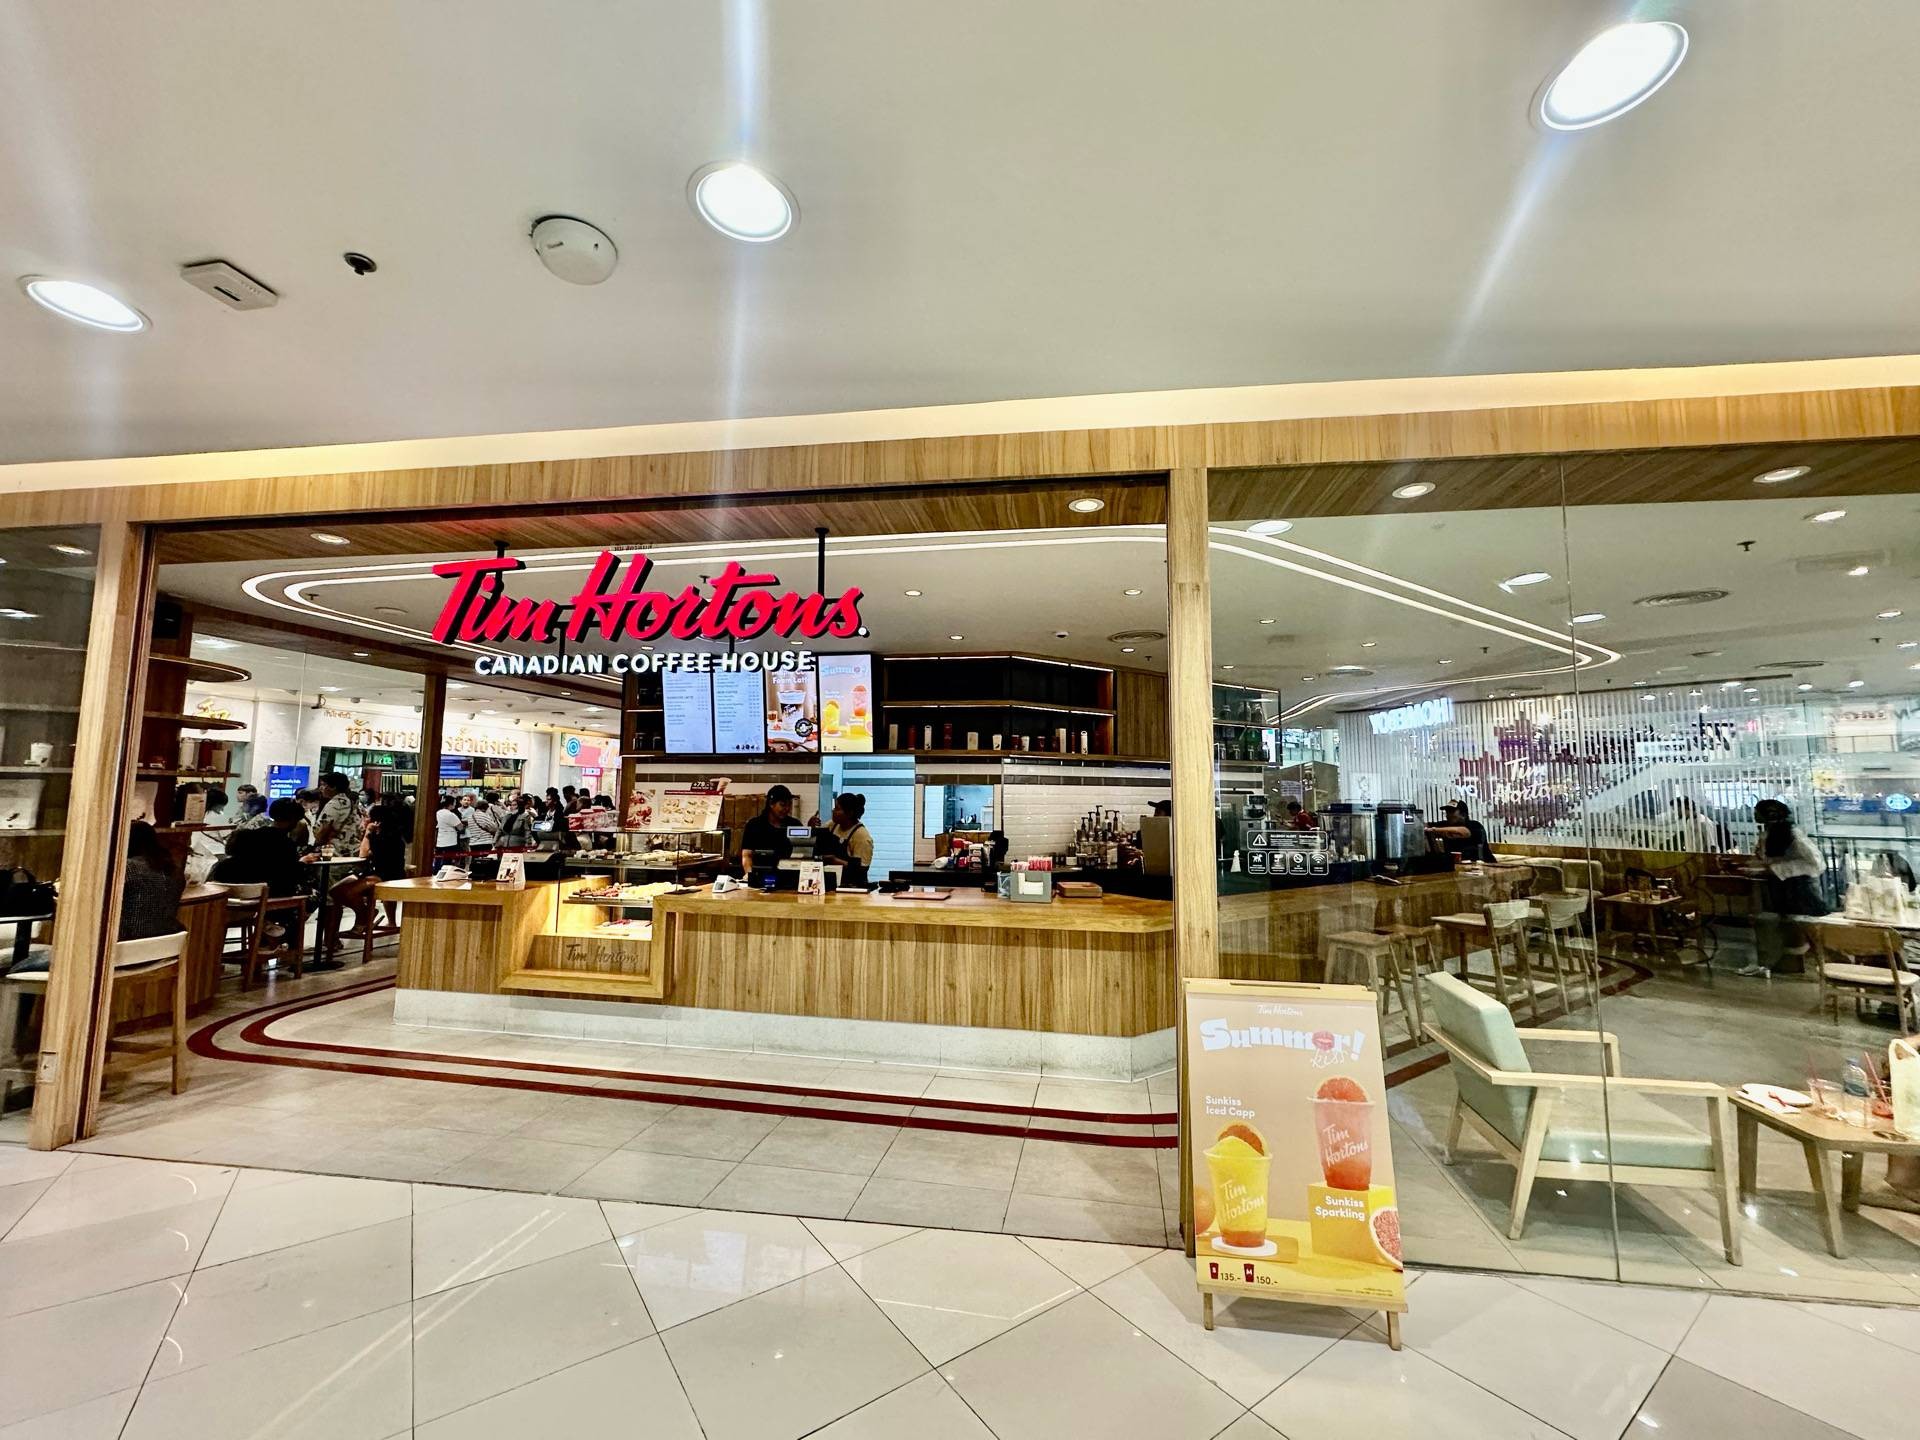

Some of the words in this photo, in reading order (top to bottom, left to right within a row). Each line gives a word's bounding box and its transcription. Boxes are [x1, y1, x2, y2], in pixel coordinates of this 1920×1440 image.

[431, 557, 554, 643] Tim
[474, 654, 602, 676] CANADIAN
[613, 652, 711, 675] COFFEE
[722, 650, 812, 672] HOUSE
[566, 944, 587, 961] Tim
[1257, 1004, 1272, 1016] Tim
[1199, 1017, 1366, 1061] Summr!
[1205, 1095, 1242, 1106] Sunkiss
[1206, 1106, 1227, 1116] Iced
[1228, 1106, 1256, 1119] Capp
[1322, 1123, 1350, 1145] Tim
[1220, 1179, 1248, 1200] Tim
[1325, 1195, 1364, 1208] Sunkiss
[1315, 1206, 1366, 1222] Sparkling
